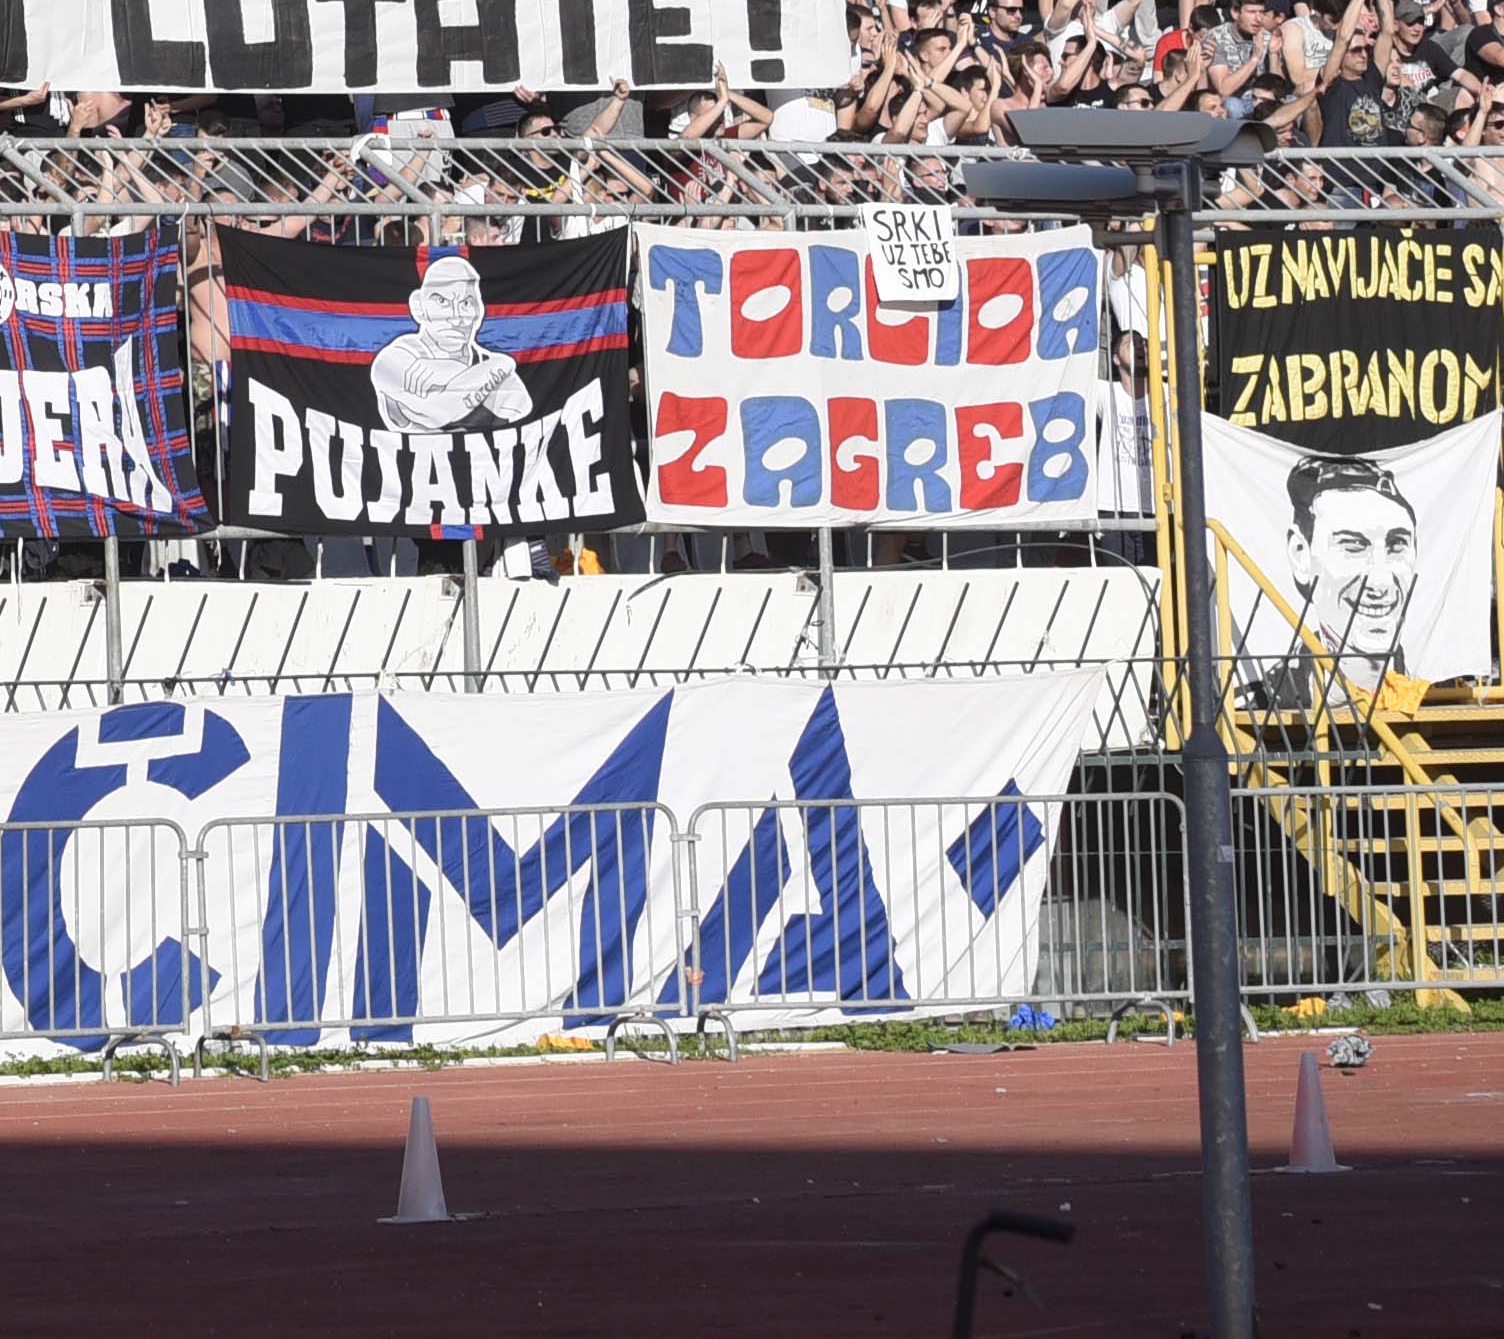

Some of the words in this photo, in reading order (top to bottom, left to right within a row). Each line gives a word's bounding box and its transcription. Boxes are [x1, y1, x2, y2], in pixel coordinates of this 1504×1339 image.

[873, 209, 943, 242] SRKI
[881, 244, 905, 266] UZ
[909, 241, 953, 264] TEBE
[899, 266, 945, 290] SMO
[1223, 243, 1278, 309] UZ
[1281, 227, 1455, 305] NAVIJAČE
[247, 376, 616, 525] PUJANKE
[655, 390, 1090, 513] ZAGREB
